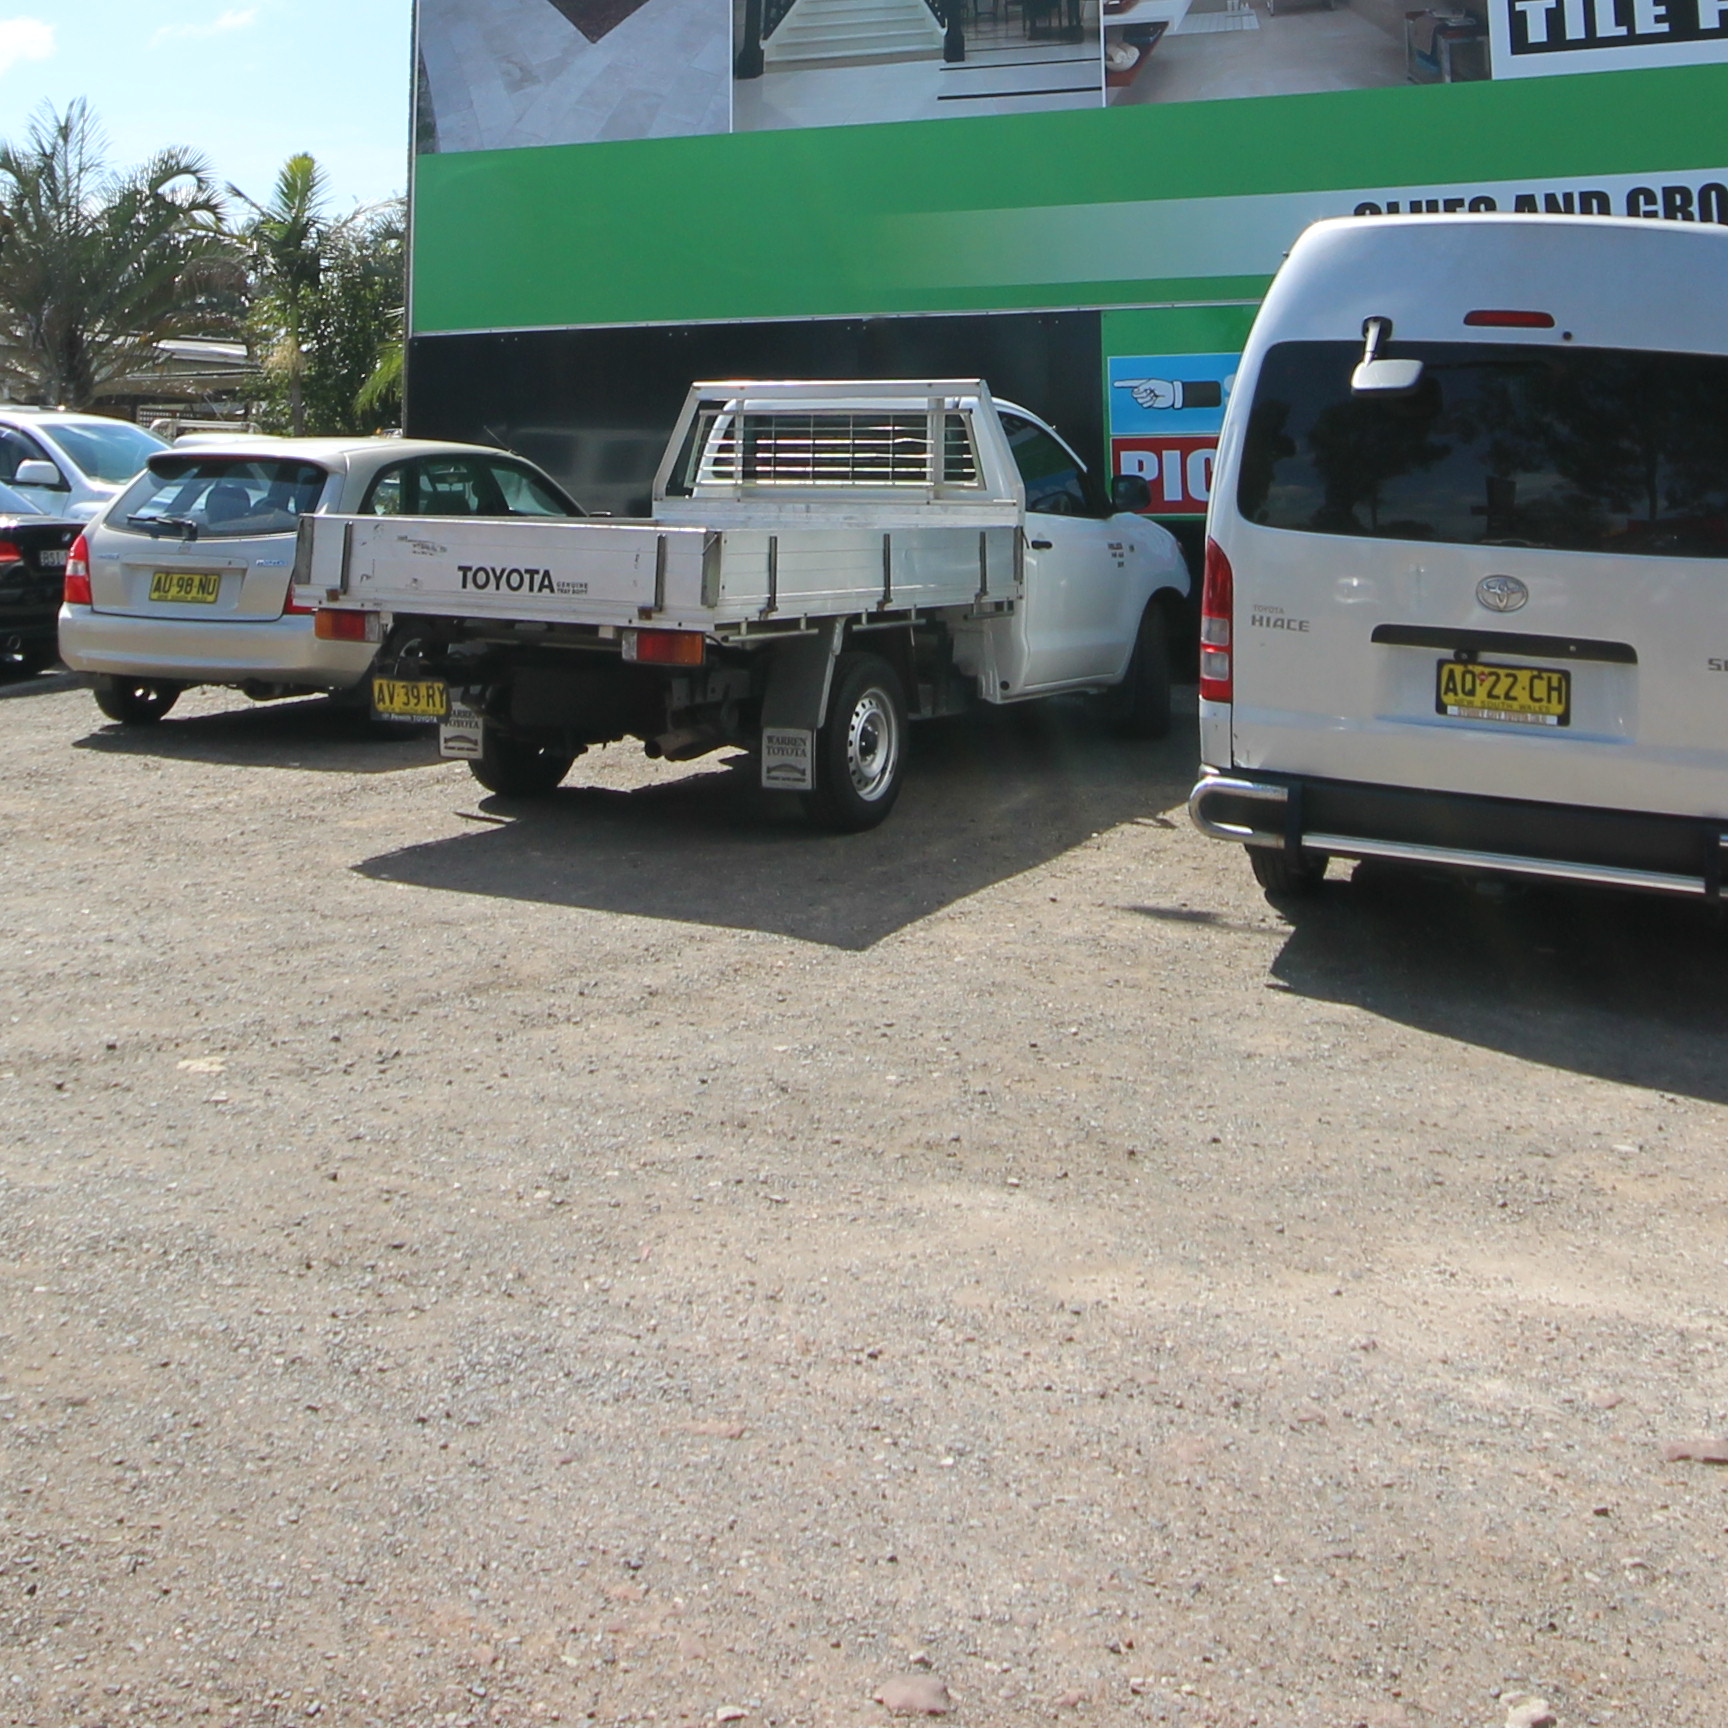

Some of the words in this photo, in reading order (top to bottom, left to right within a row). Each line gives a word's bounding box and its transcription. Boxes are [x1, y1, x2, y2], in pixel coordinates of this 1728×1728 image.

[457, 565, 555, 594] TOYOTA
[1254, 604, 1285, 614] TOYOTA
[1251, 614, 1310, 632] HIACE
[766, 735, 807, 747] WARREN
[766, 746, 807, 757] TOYOTA
